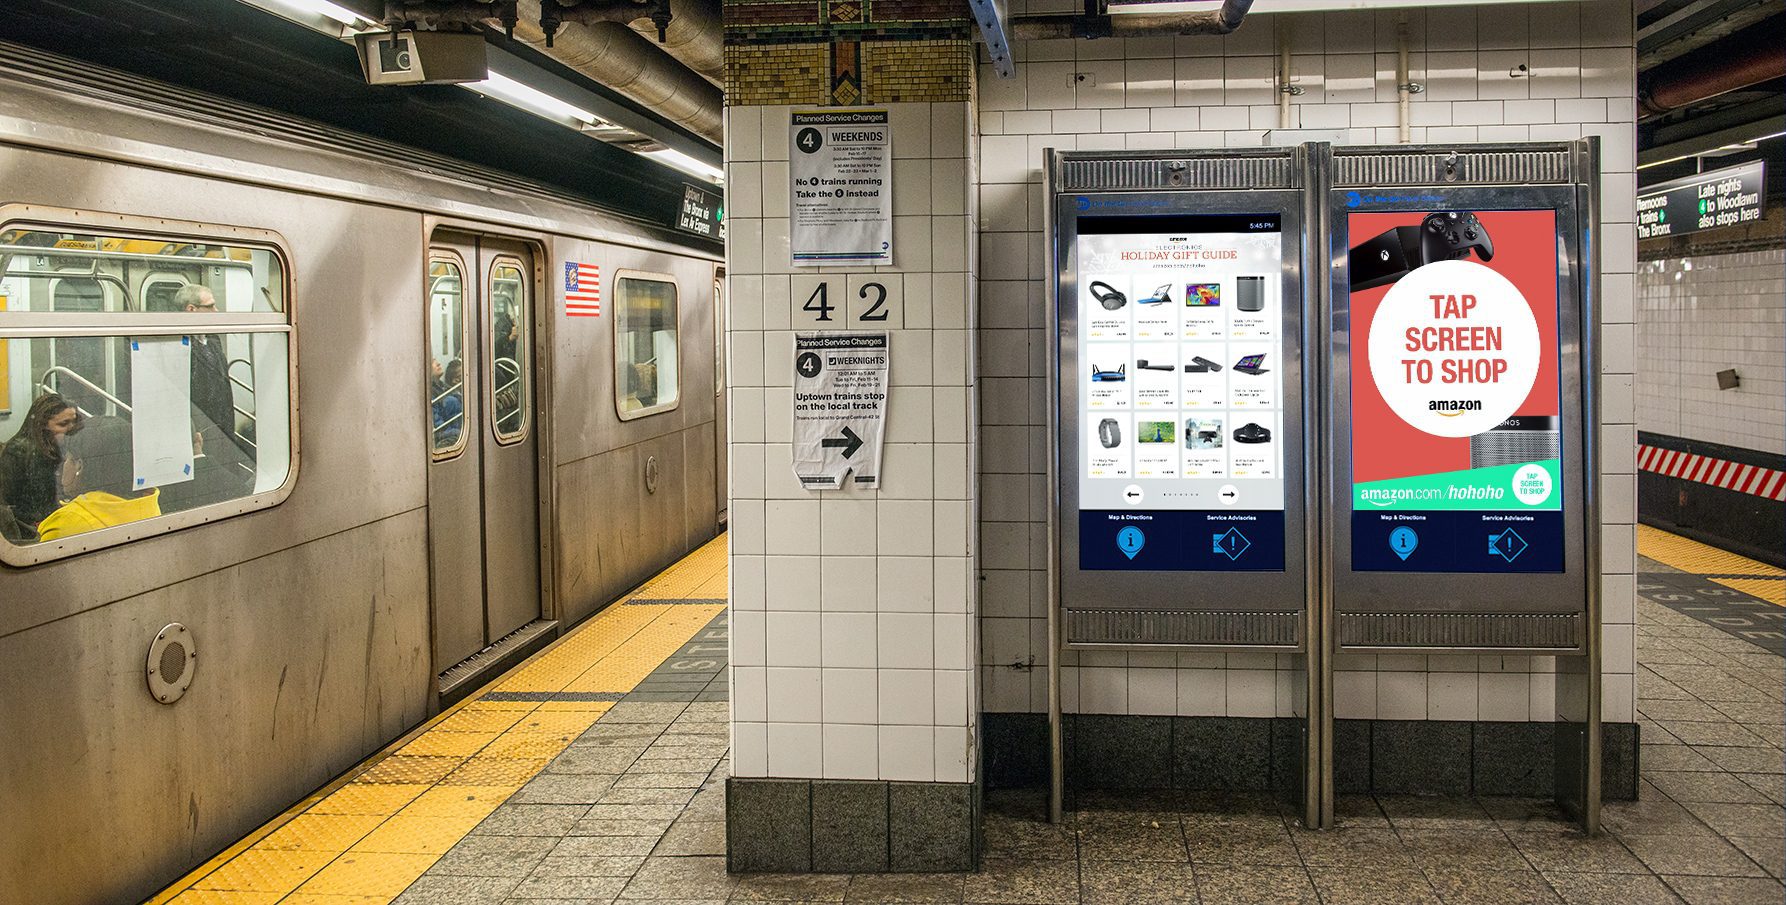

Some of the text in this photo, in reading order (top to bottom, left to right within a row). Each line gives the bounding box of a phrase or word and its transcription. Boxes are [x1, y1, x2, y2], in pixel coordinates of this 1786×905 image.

[852, 114, 884, 122] Changes
[802, 132, 814, 148] 4
[832, 132, 883, 142] WEEKENDS
[848, 177, 882, 186] running
[1698, 178, 1742, 198] Late nights
[1707, 200, 1716, 212] to
[1717, 192, 1758, 210] Woodlawn
[1640, 210, 1658, 224] trains
[1698, 207, 1760, 228] also stops here
[694, 218, 710, 234] Express
[1638, 223, 1671, 238] The Bronx
[1120, 251, 1238, 260] HOLIDAY GIFT GUIDE
[1429, 294, 1476, 319] TAP
[851, 338, 882, 346] Changes
[1405, 326, 1502, 352] SCREEN
[802, 357, 813, 372] 4
[1401, 359, 1508, 384] TO SHOP
[796, 393, 832, 402] Uptown
[864, 392, 885, 401] stop
[1429, 400, 1482, 412] amazon
[1361, 484, 1504, 500] amazon.com/hohoho
